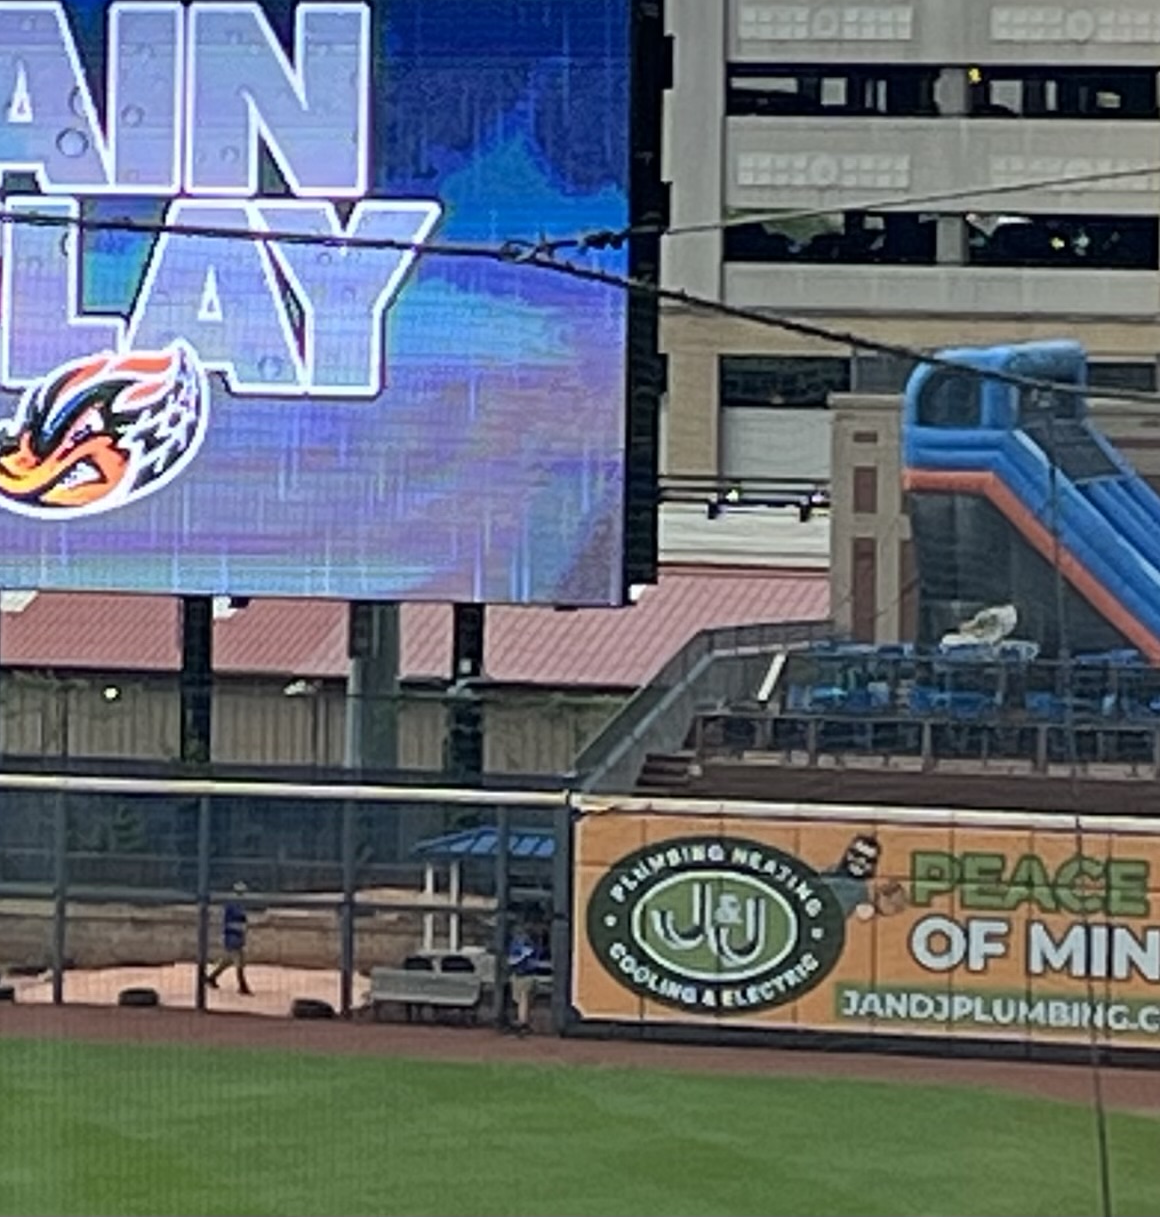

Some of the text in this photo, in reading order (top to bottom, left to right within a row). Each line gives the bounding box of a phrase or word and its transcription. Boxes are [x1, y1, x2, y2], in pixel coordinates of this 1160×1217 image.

[609, 843, 824, 918] PLUMBING HEATING
[910, 849, 1151, 918] PEACE
[609, 942, 698, 1004] COOLING
[721, 952, 820, 1007] ELECTRIC
[908, 913, 1160, 982] OF MIN
